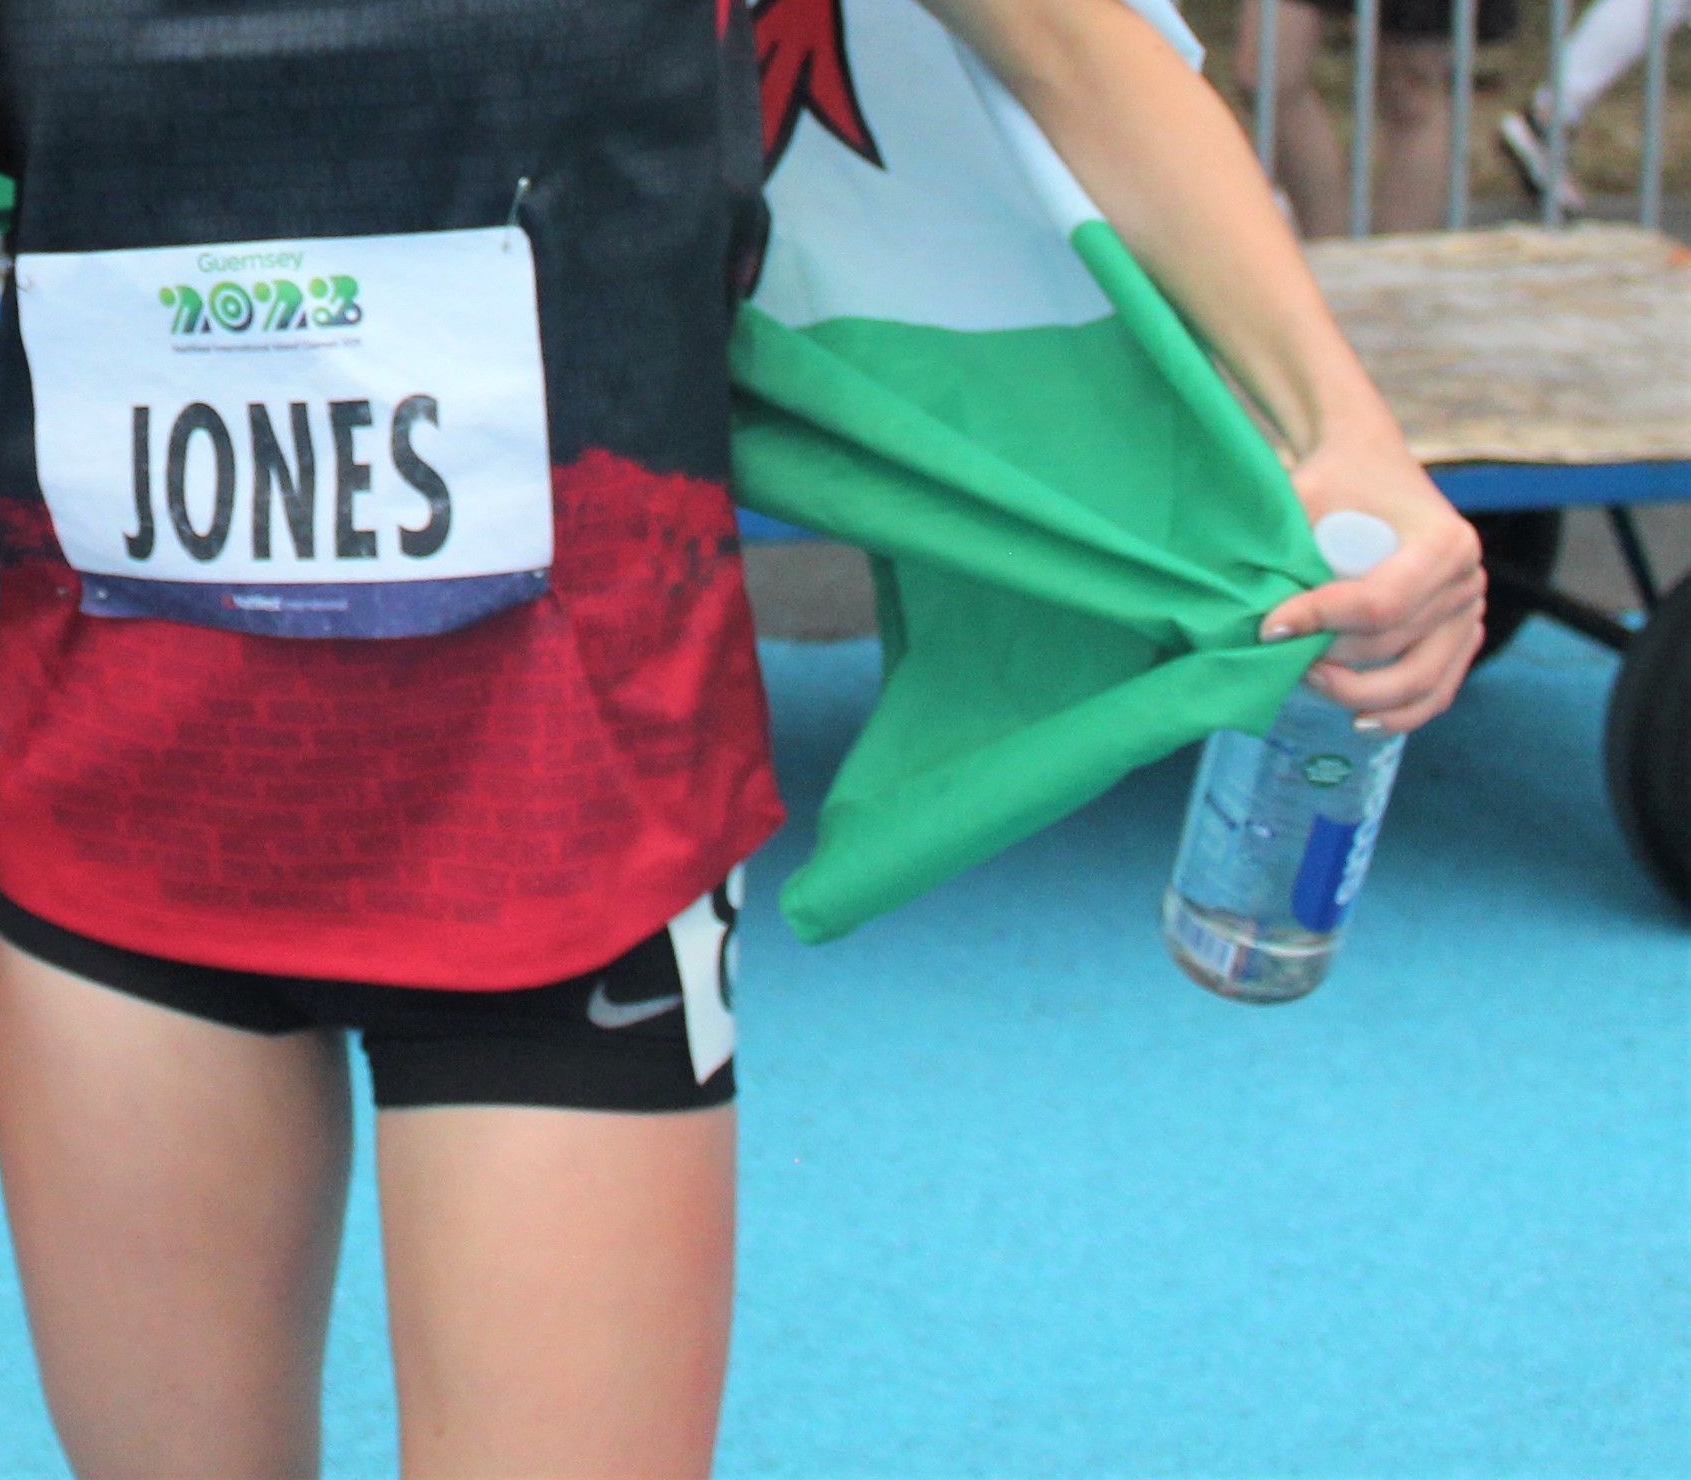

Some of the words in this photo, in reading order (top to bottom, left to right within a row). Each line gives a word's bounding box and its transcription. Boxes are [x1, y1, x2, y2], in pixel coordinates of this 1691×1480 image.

[196, 250, 304, 273] Guernsey
[158, 274, 362, 335] 2023
[123, 393, 453, 562] JONES
